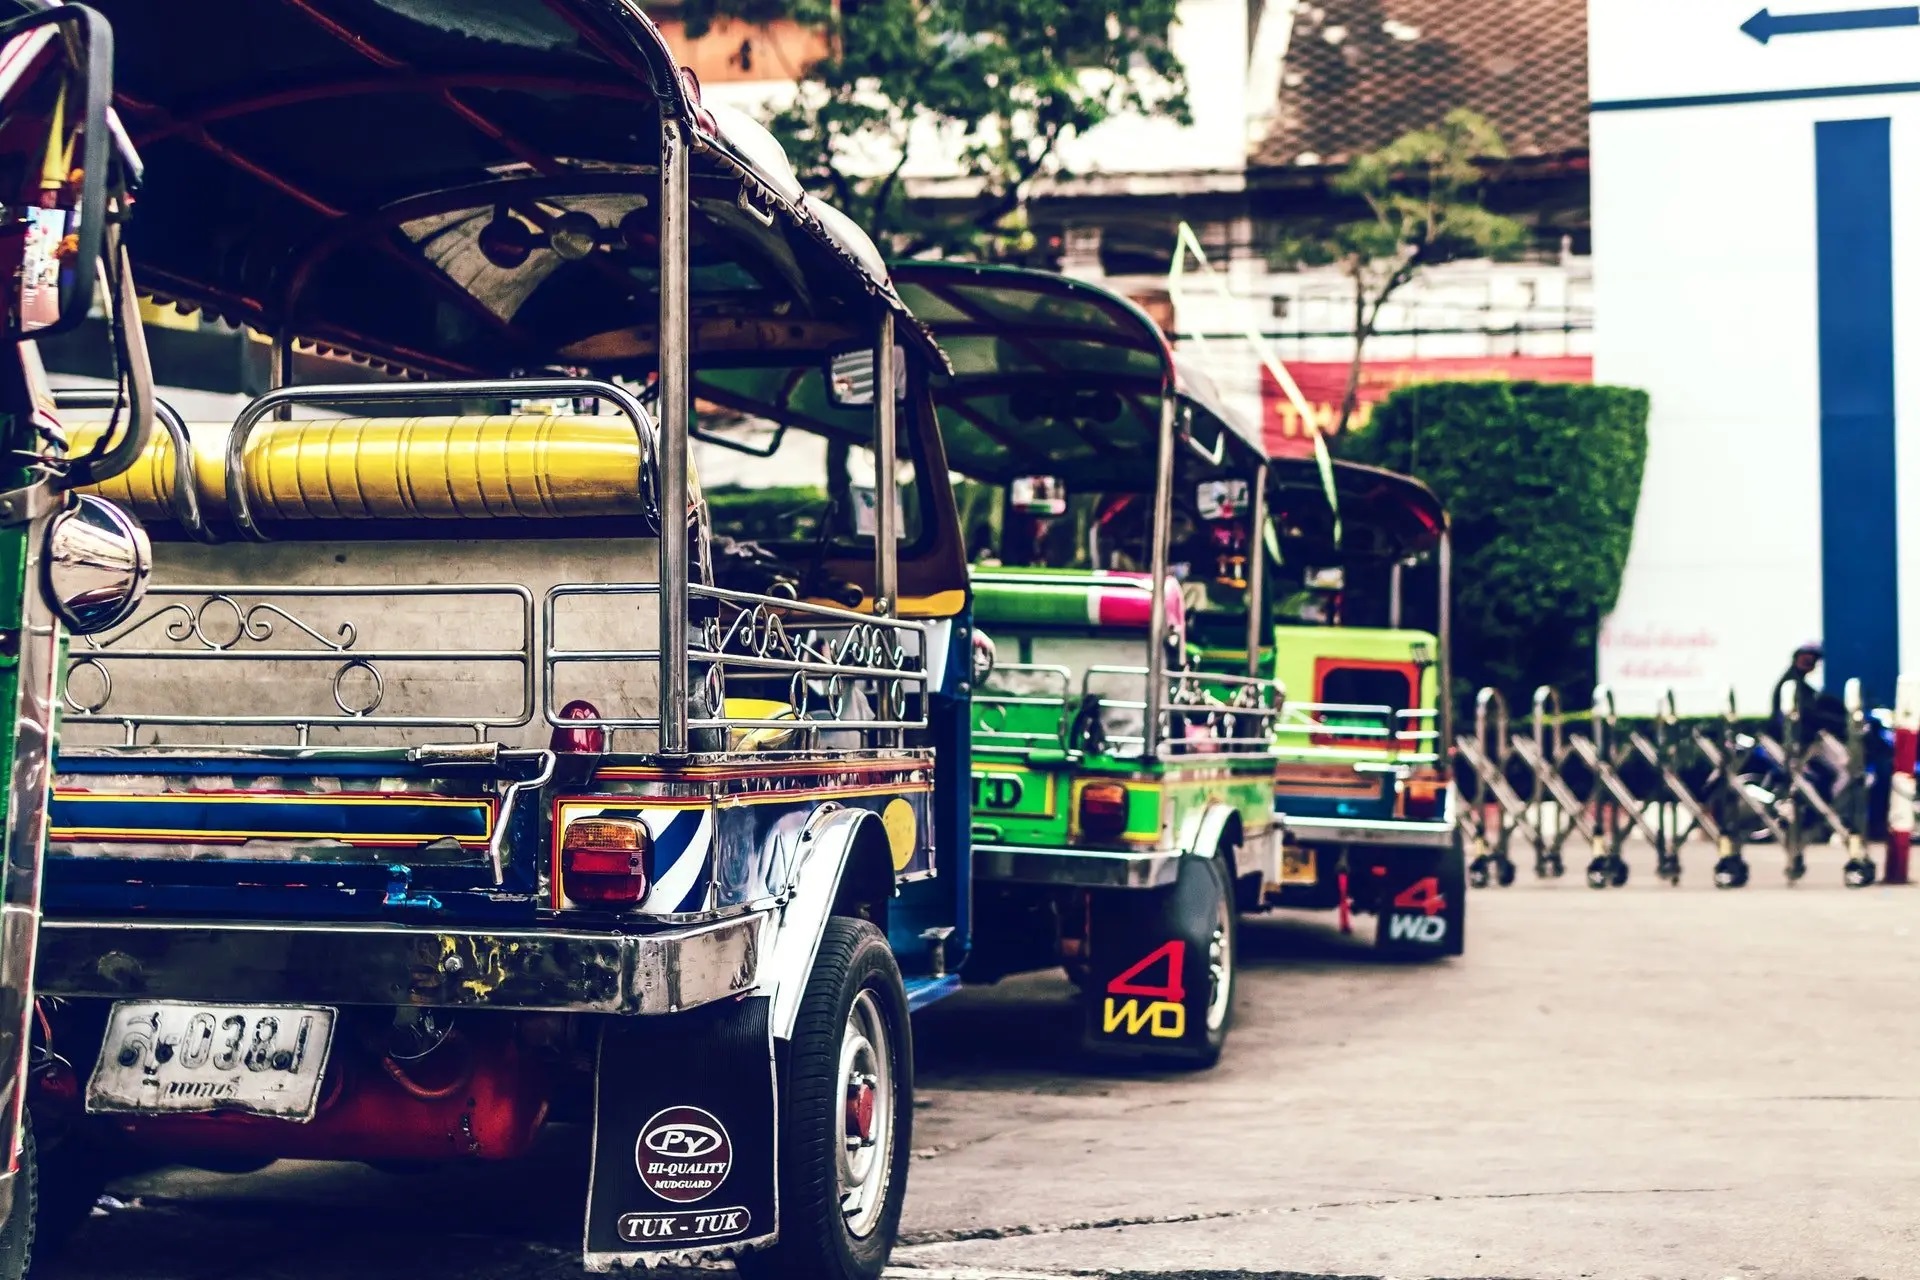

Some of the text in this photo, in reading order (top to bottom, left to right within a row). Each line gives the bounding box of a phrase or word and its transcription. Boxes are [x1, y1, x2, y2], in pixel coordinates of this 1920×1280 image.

[1394, 877, 1447, 915] 4
[1389, 914, 1447, 942] WD
[1107, 940, 1185, 1002] 4
[1103, 997, 1185, 1038] WD
[647, 1162, 727, 1177] HI-QUALITY
[654, 1180, 712, 1189] MUDGUARD
[628, 1217, 676, 1237] TUK
[695, 1212, 742, 1234] TUK
